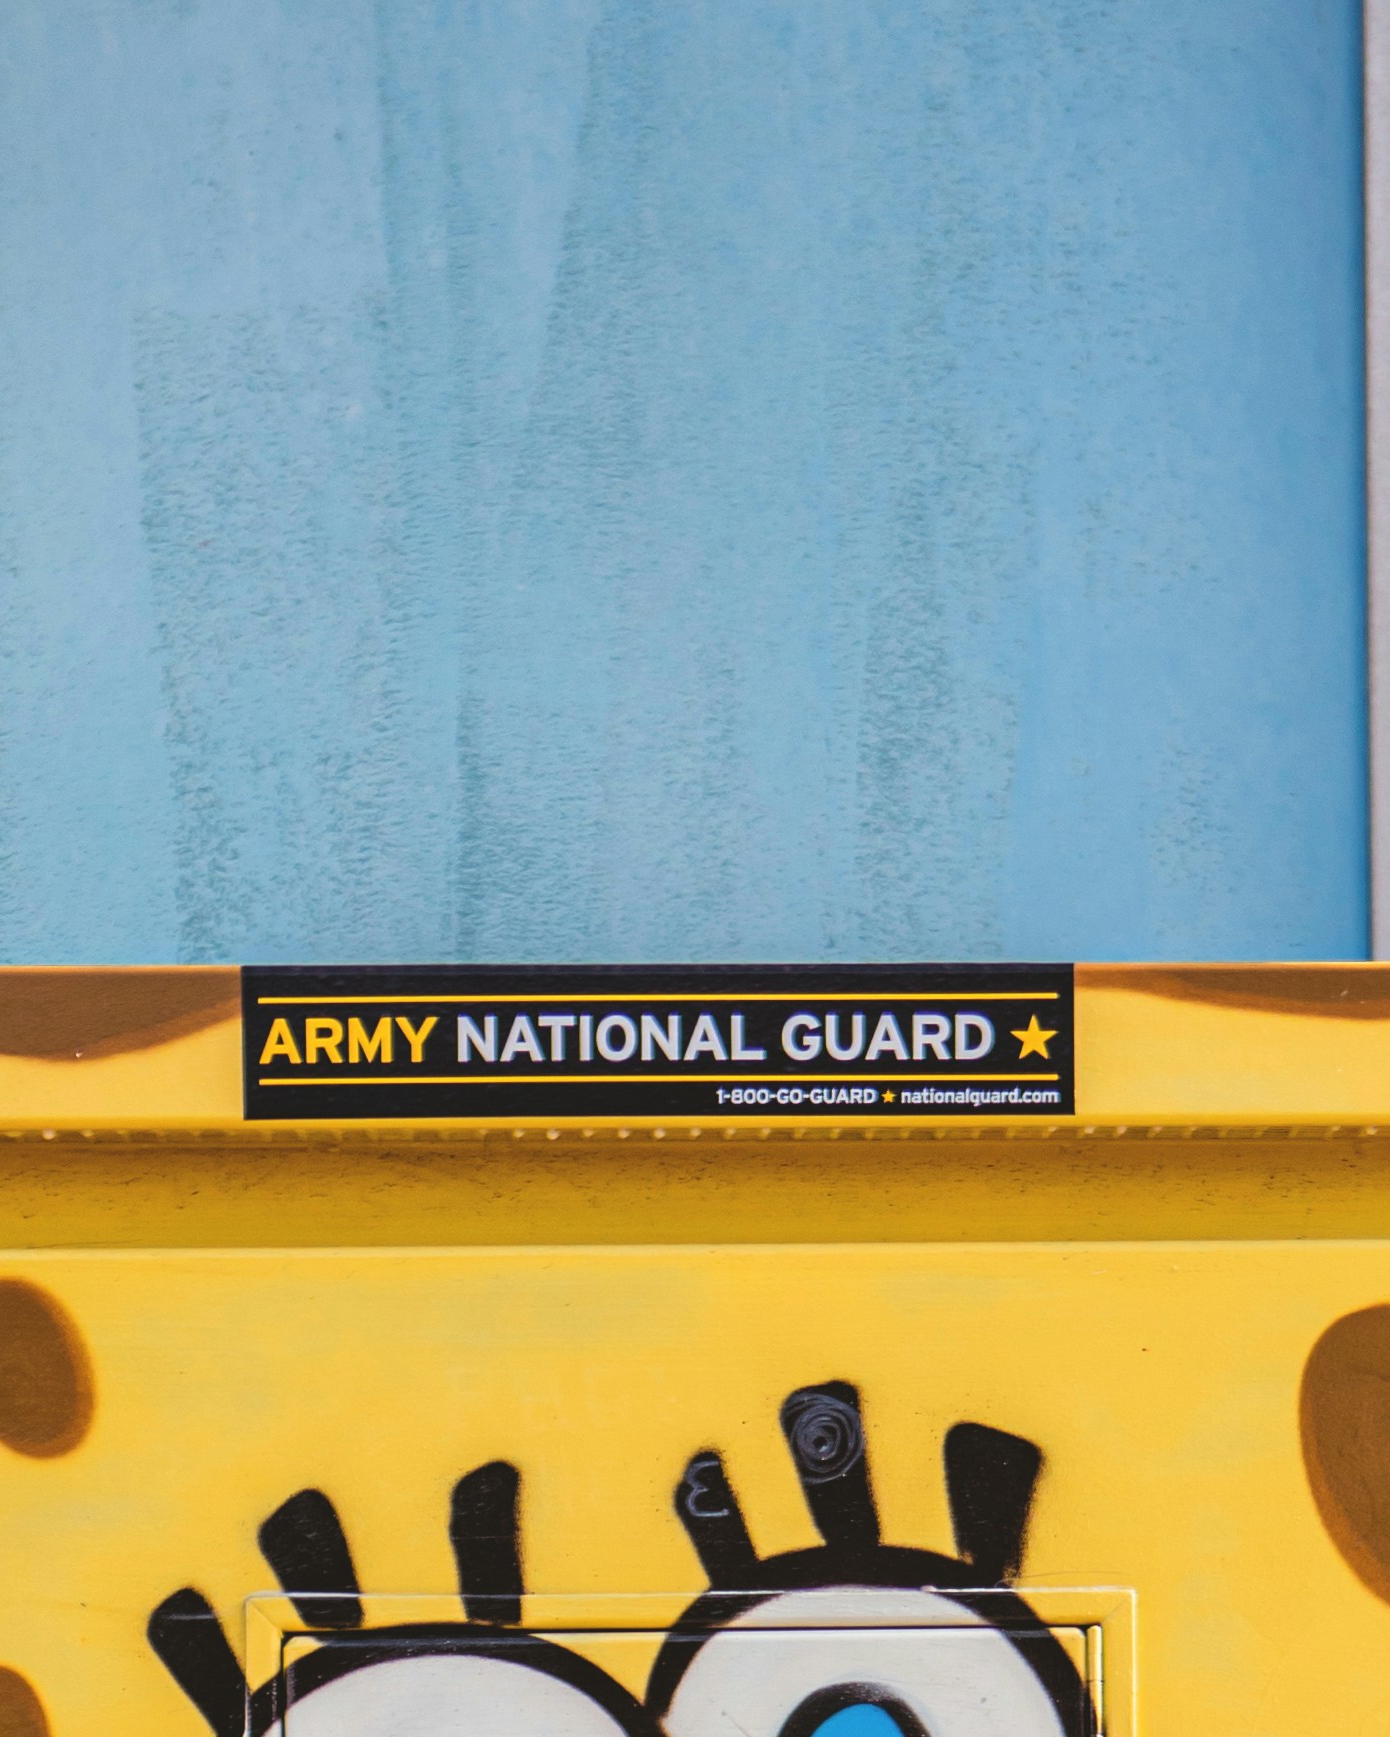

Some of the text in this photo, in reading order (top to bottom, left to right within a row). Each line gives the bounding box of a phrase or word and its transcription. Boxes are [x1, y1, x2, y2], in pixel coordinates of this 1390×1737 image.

[258, 1011, 996, 1065] ARMY NATIONAL GUARD
[715, 1086, 1061, 1107] 1-800-GO-GUARD nationalguard.com
